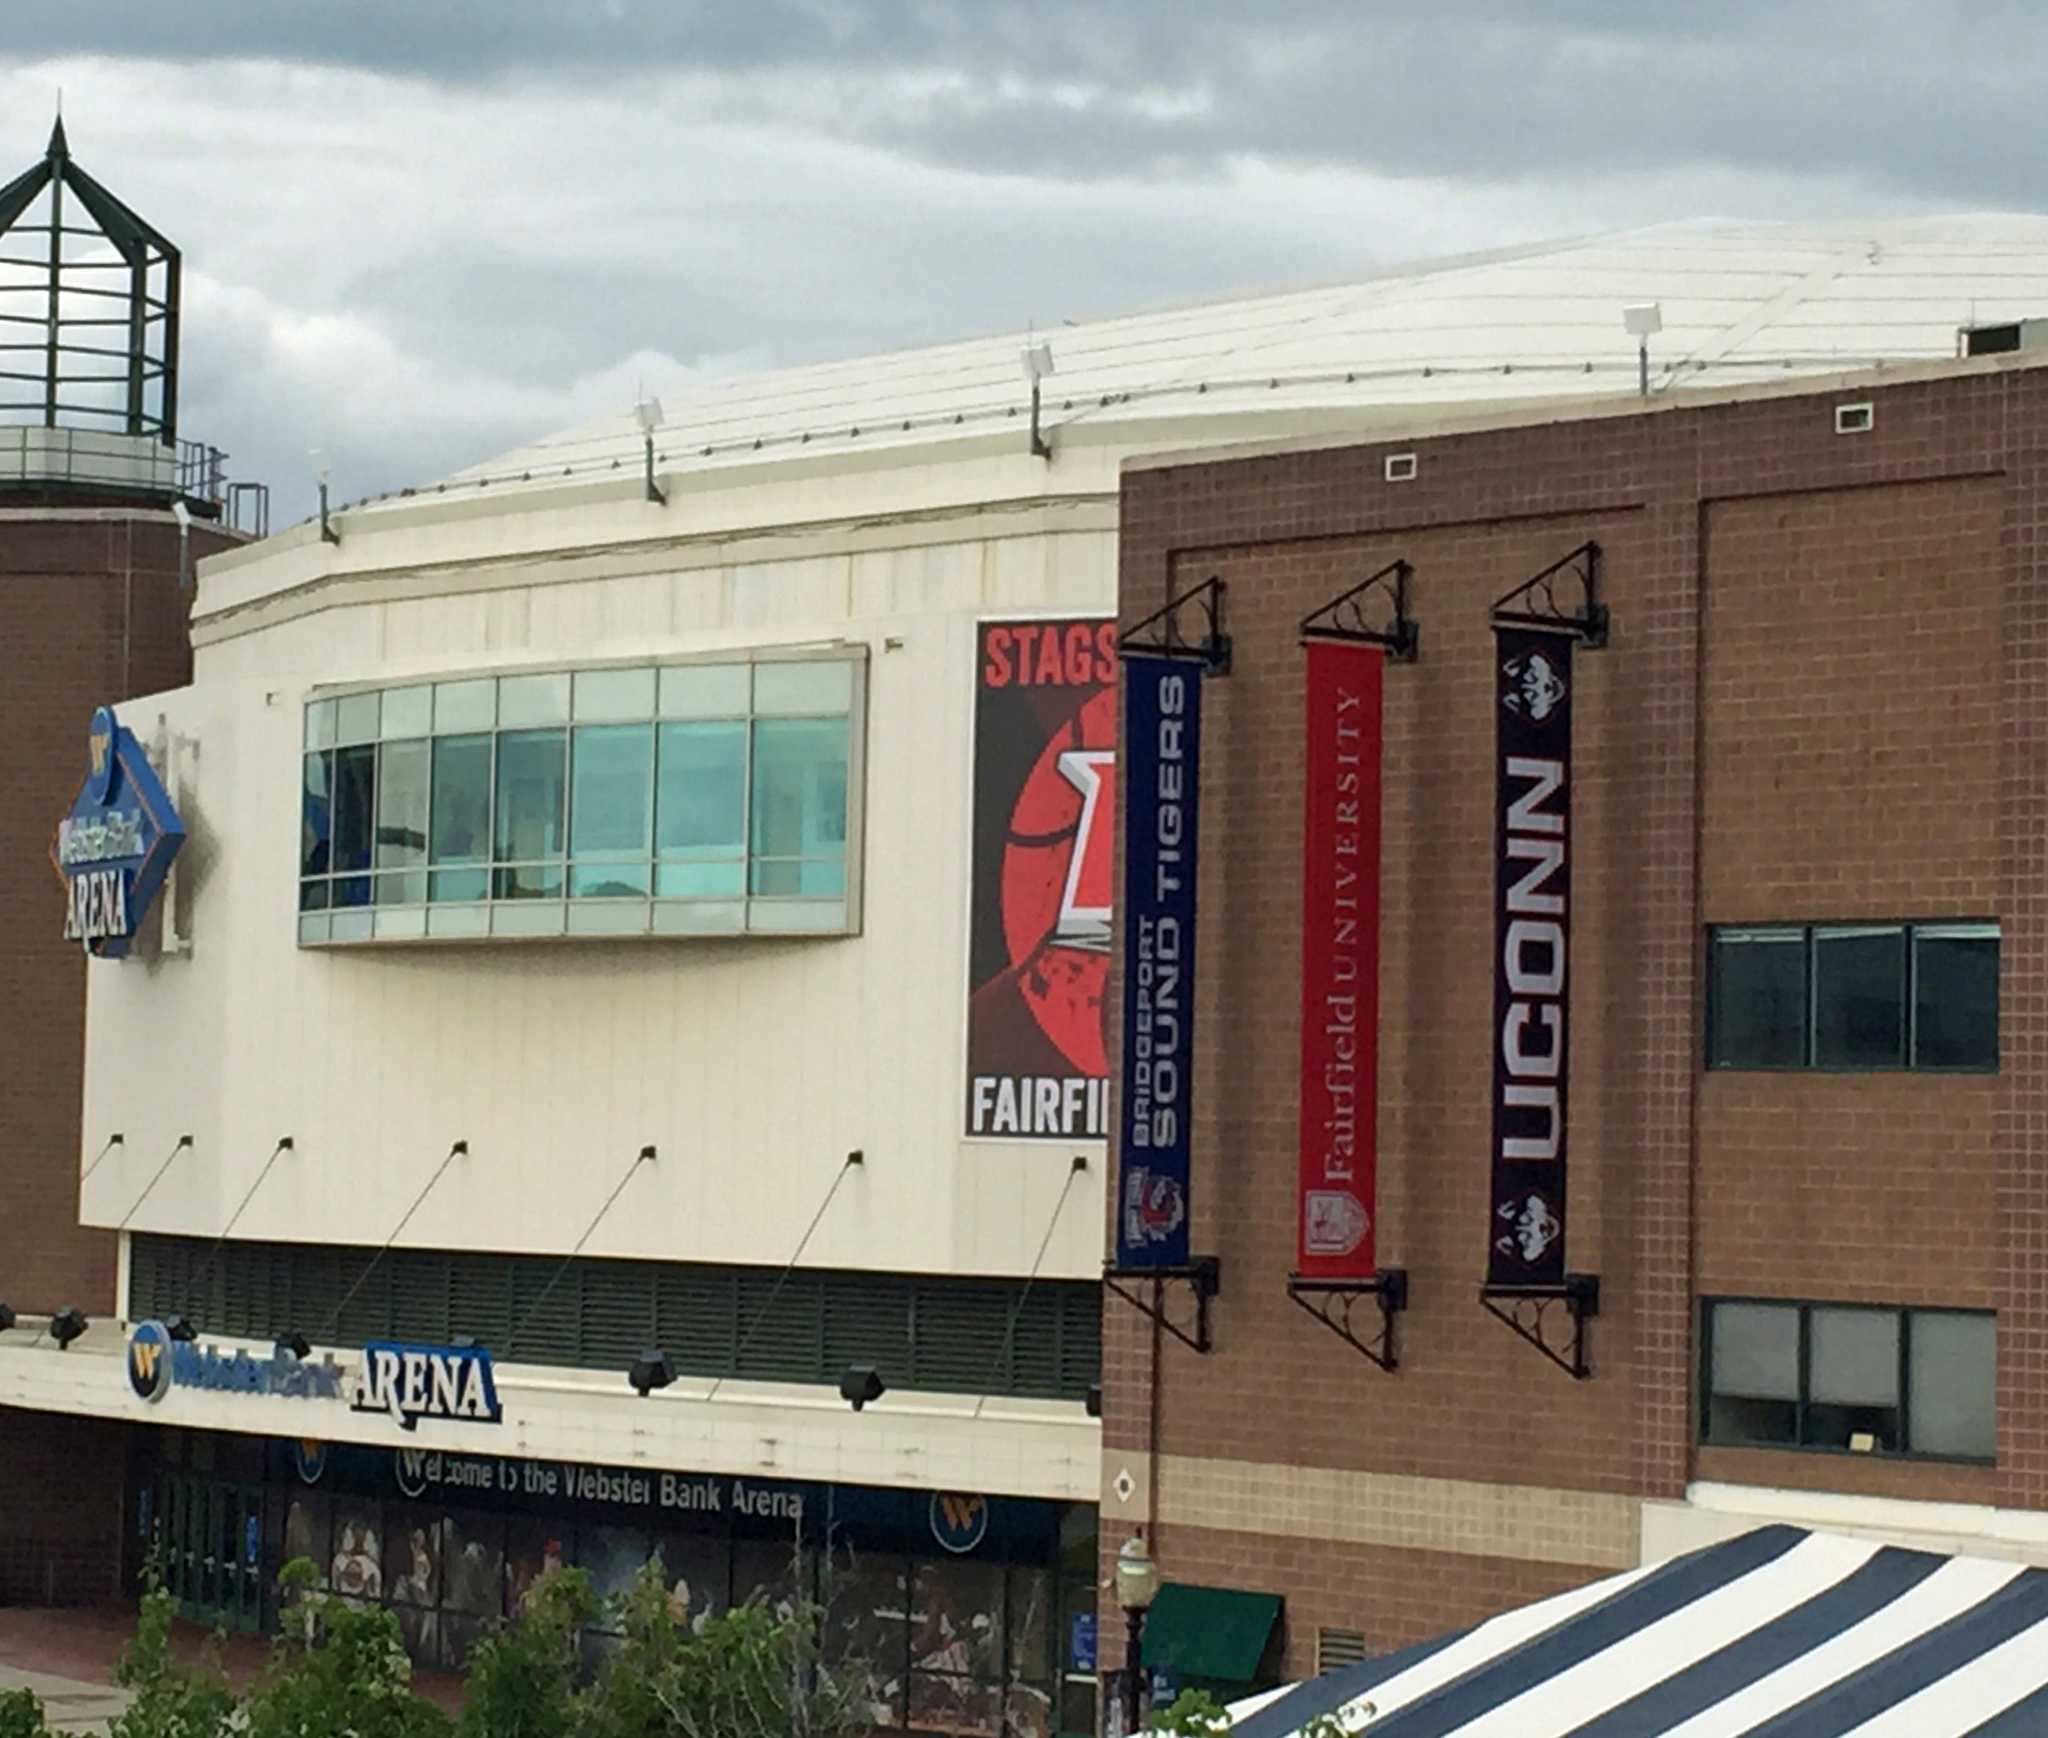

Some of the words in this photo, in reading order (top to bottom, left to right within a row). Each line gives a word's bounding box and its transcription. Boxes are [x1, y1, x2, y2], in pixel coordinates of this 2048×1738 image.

[985, 624, 1117, 687] STAGS
[1157, 675, 1184, 902] TIGERS
[1334, 688, 1360, 982] UNIVERSITY
[64, 869, 127, 952] ARENA
[1503, 756, 1564, 1159] UCONN
[1133, 915, 1153, 1147] BRIDGEPORT
[1153, 917, 1179, 1148] SOUND
[1324, 995, 1356, 1182] Fairfield
[352, 1348, 493, 1424] ARENA
[523, 1462, 558, 1495] the
[660, 1474, 721, 1512] Bank
[732, 1481, 804, 1519] Arena
